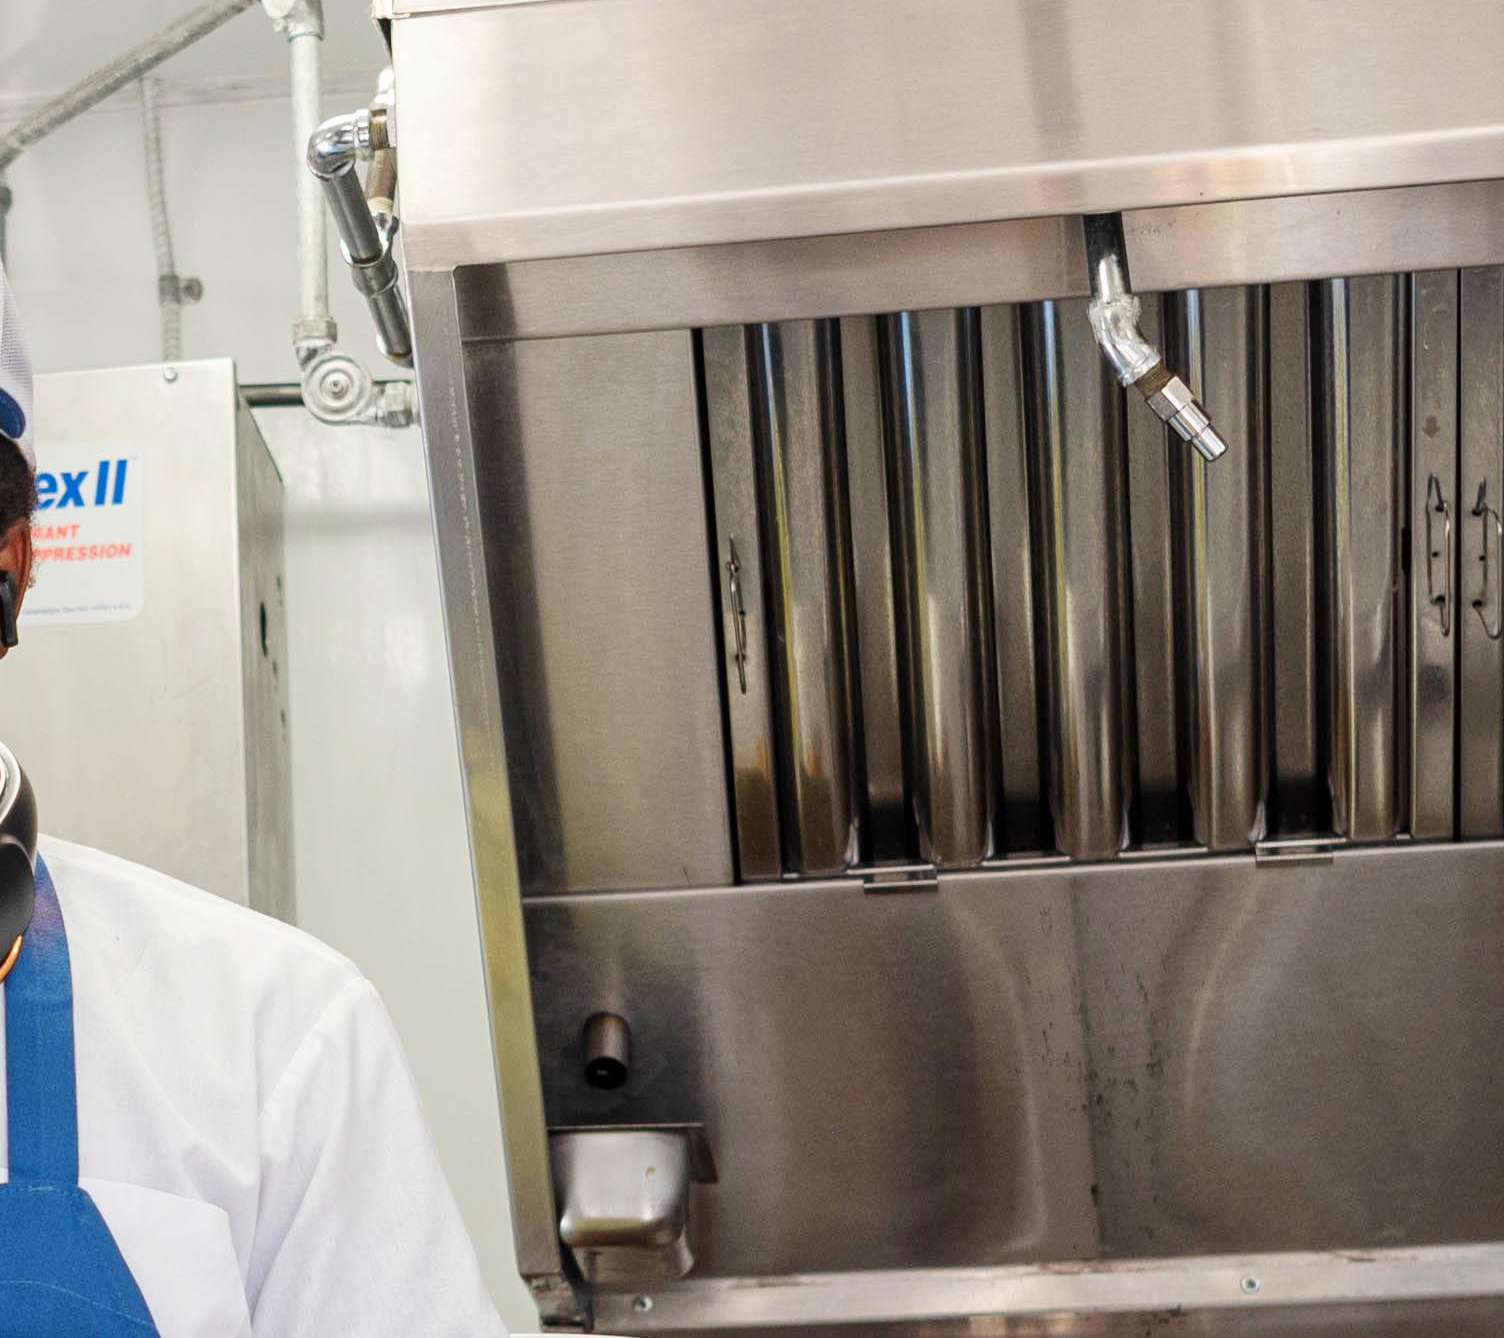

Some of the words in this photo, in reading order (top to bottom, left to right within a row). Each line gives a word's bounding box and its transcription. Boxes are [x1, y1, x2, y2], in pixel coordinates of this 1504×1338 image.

[34, 470, 89, 511] ex
[31, 524, 80, 541] RANT
[32, 542, 132, 563] PPRESSION
